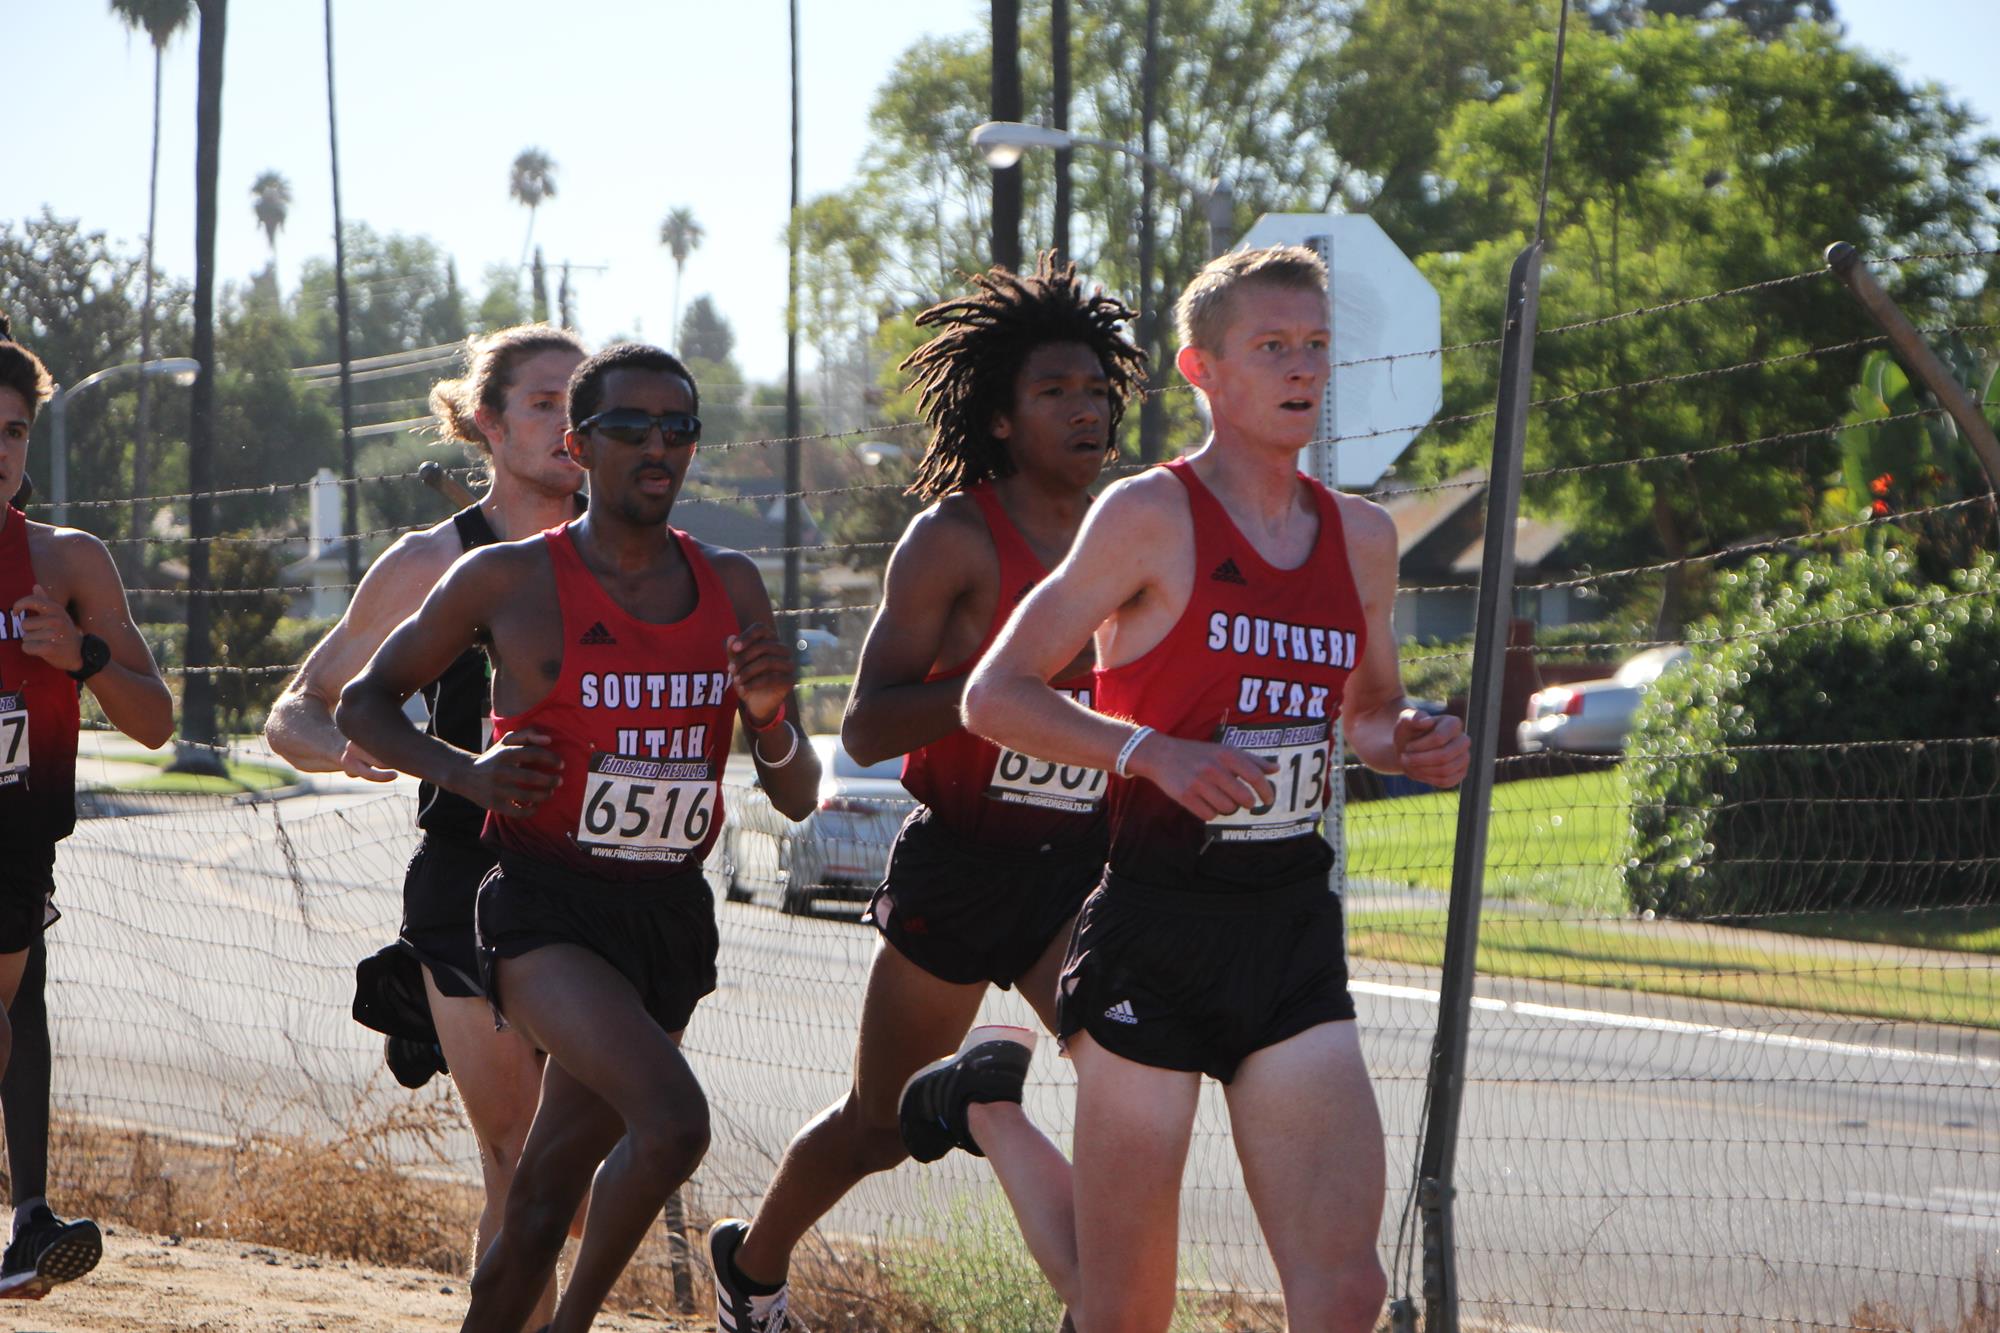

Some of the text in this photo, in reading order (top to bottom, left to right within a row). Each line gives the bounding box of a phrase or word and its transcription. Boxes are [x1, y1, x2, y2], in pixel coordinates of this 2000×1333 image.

[1208, 611, 1357, 670] SOUTHERN
[1238, 676, 1330, 718] UTAH
[617, 724, 707, 759] UTAH
[1217, 748, 1327, 817] 513
[584, 781, 710, 842] 6516
[1104, 1010, 1138, 1025] adidas
